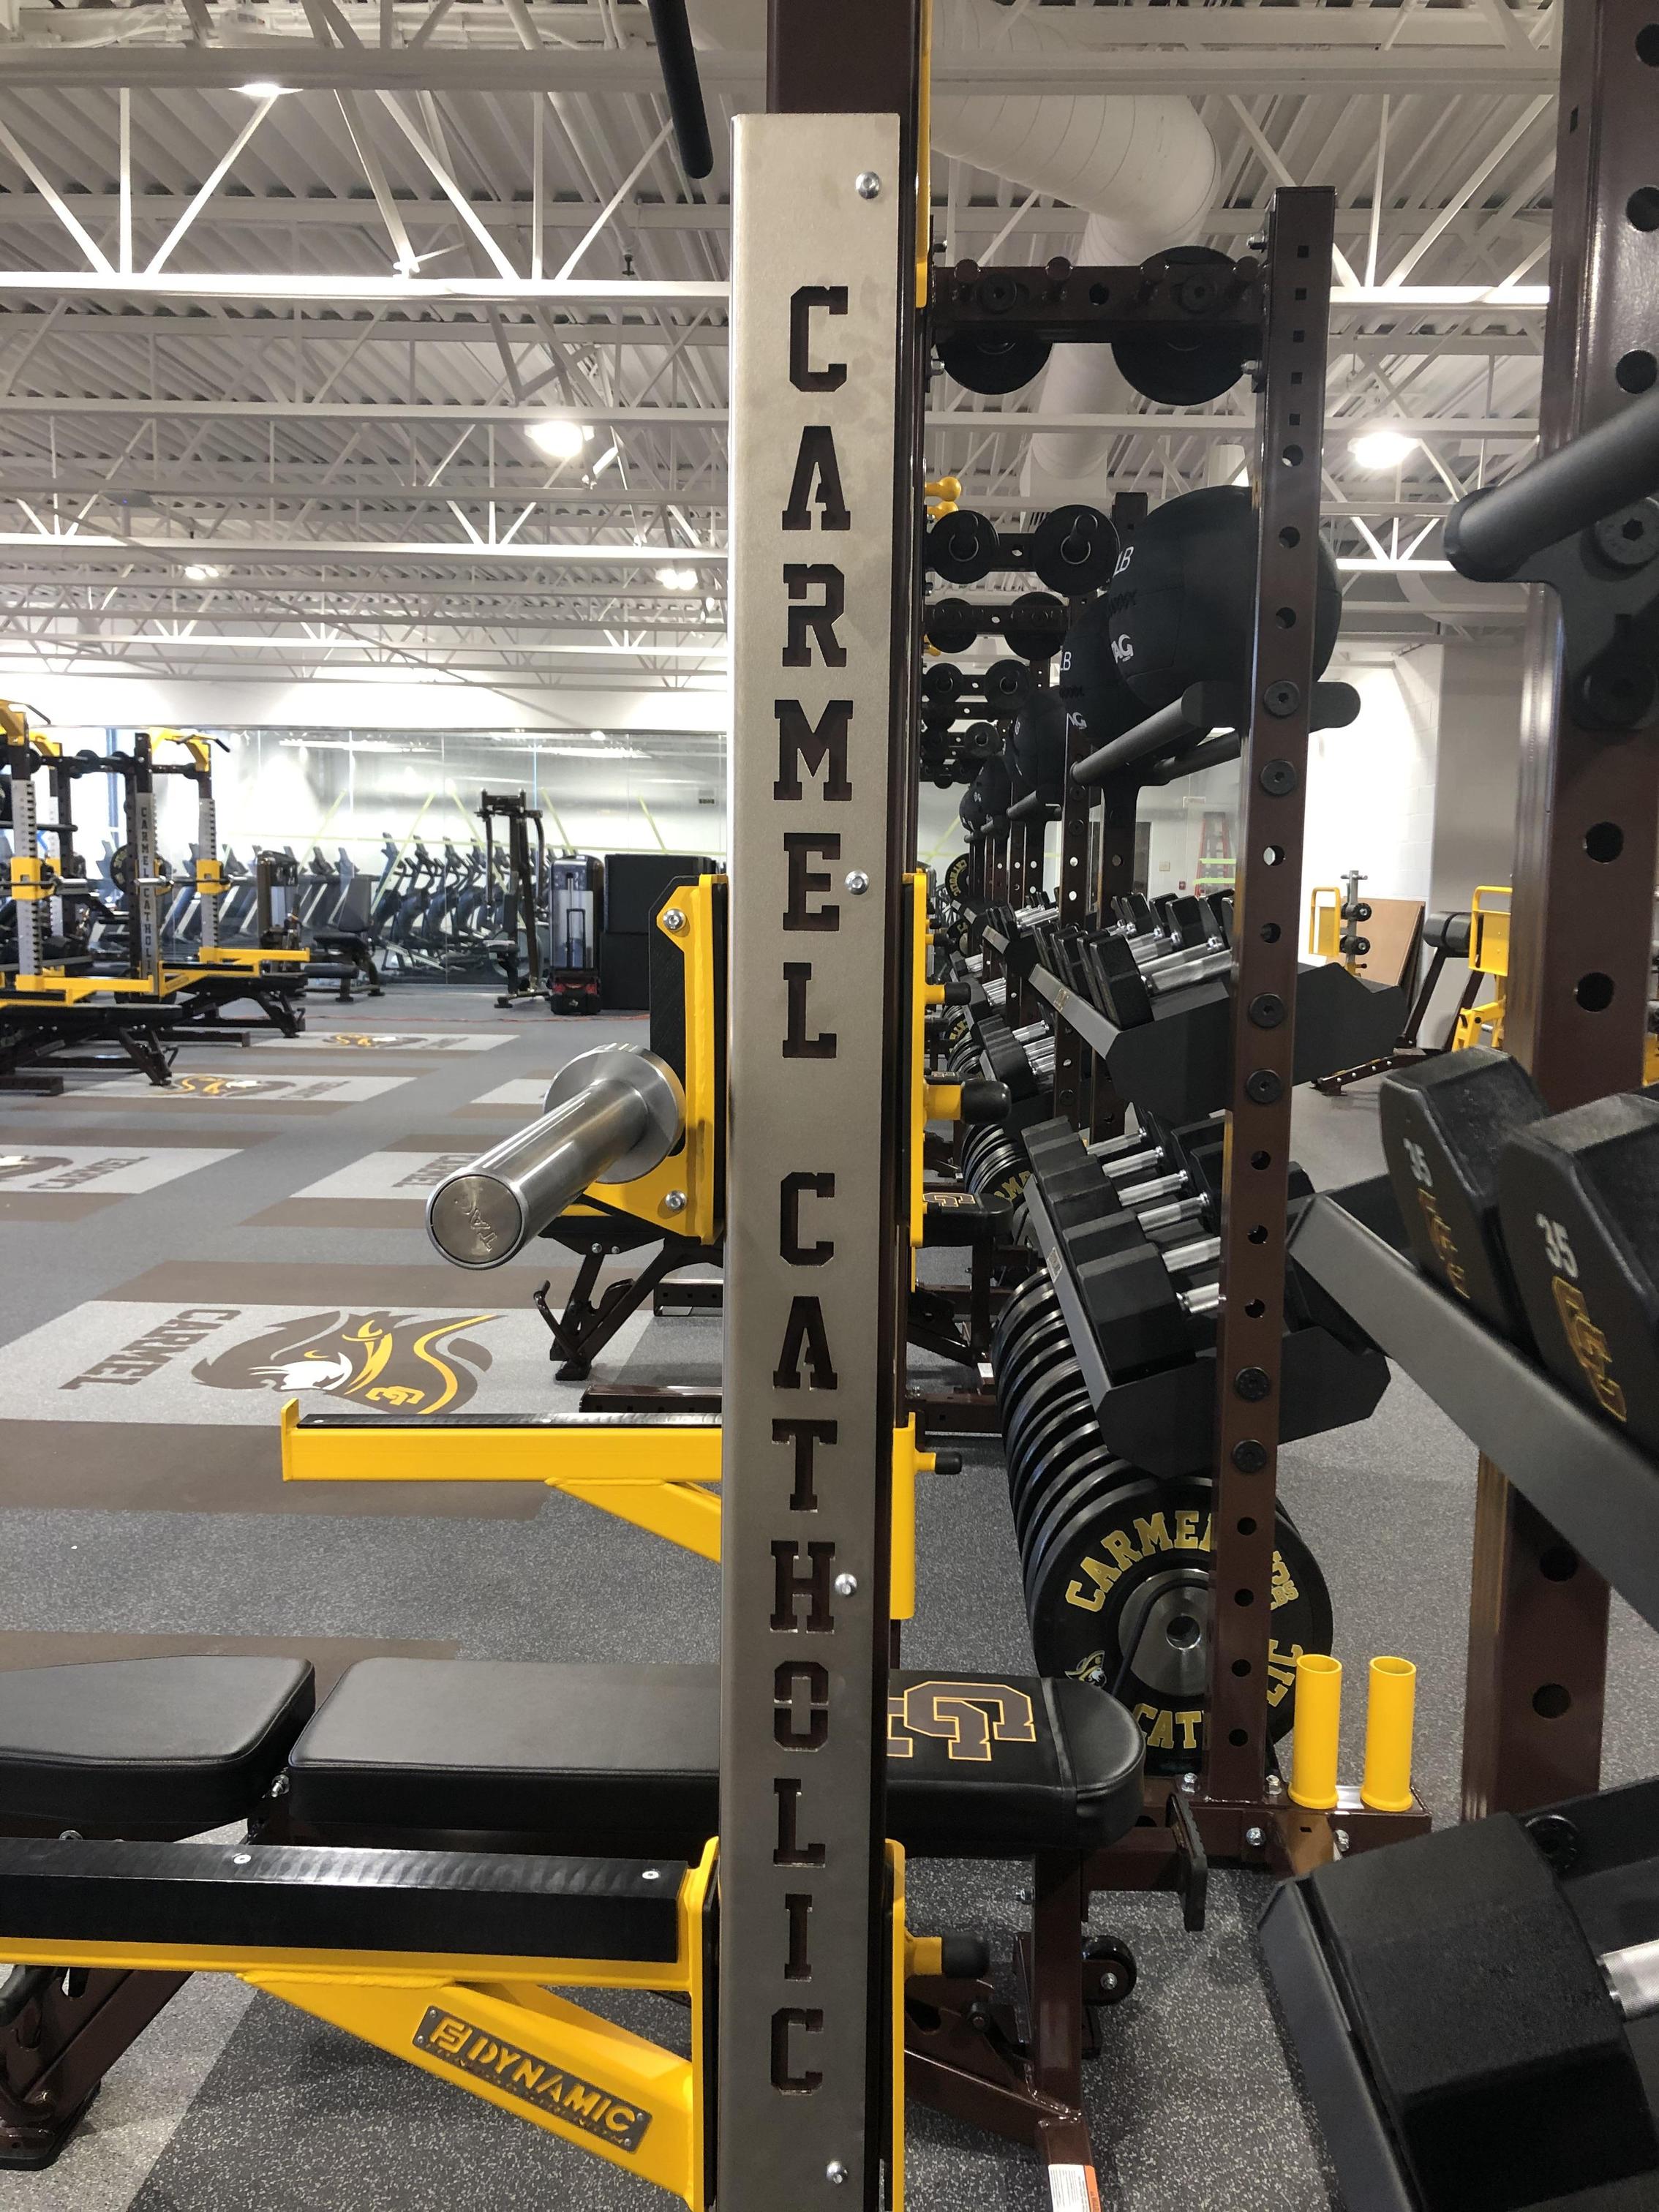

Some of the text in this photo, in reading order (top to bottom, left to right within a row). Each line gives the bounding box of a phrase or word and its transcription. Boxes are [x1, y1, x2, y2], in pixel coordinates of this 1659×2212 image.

[1111, 633, 1134, 663] AG
[141, 807, 154, 976] CARMEL CATHOLI
[770, 285, 854, 2096] CARMEL CATHOLIC
[1535, 1212, 1579, 1279] 35
[58, 1309, 242, 1390] CARMEL
[466, 2036, 636, 2132] DYNAMIC
